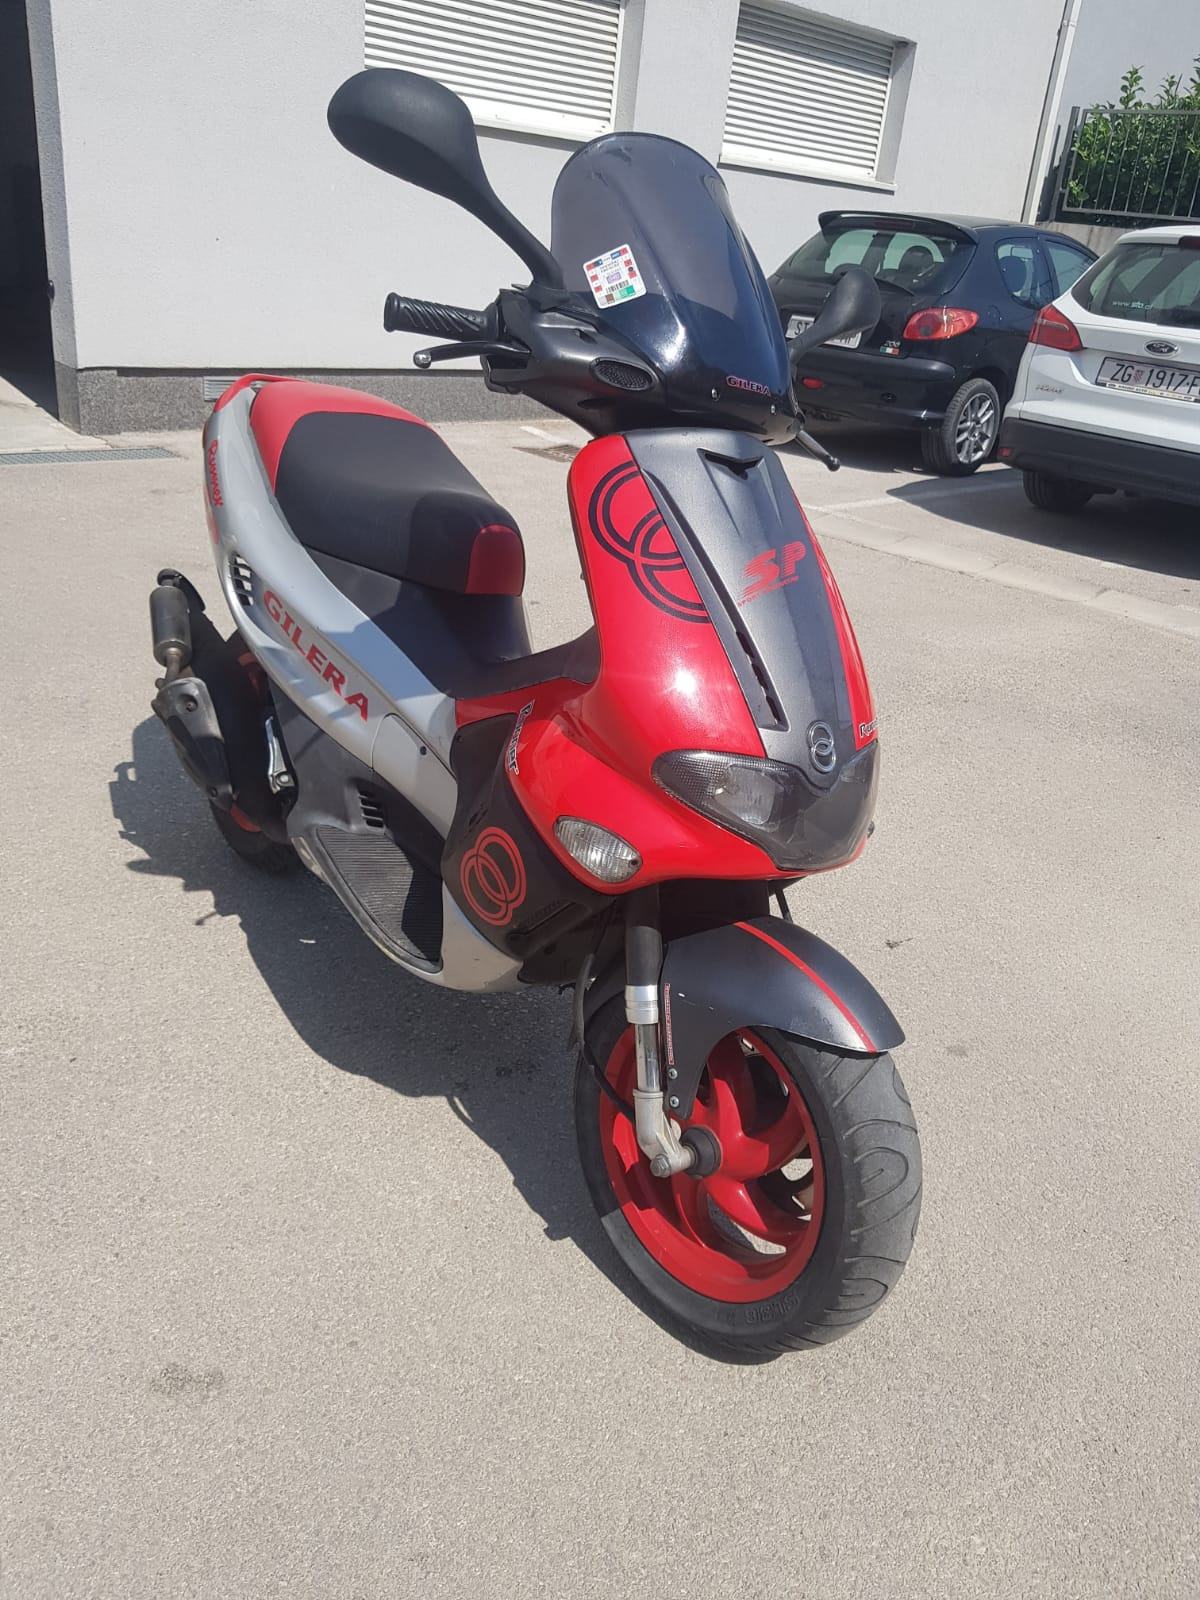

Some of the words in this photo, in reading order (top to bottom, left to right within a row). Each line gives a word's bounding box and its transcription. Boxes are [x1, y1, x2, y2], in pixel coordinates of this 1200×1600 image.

[726, 375, 771, 397] GILERA
[1110, 363, 1135, 383] ZG
[742, 541, 806, 599] SP
[263, 590, 369, 722] GILERA
